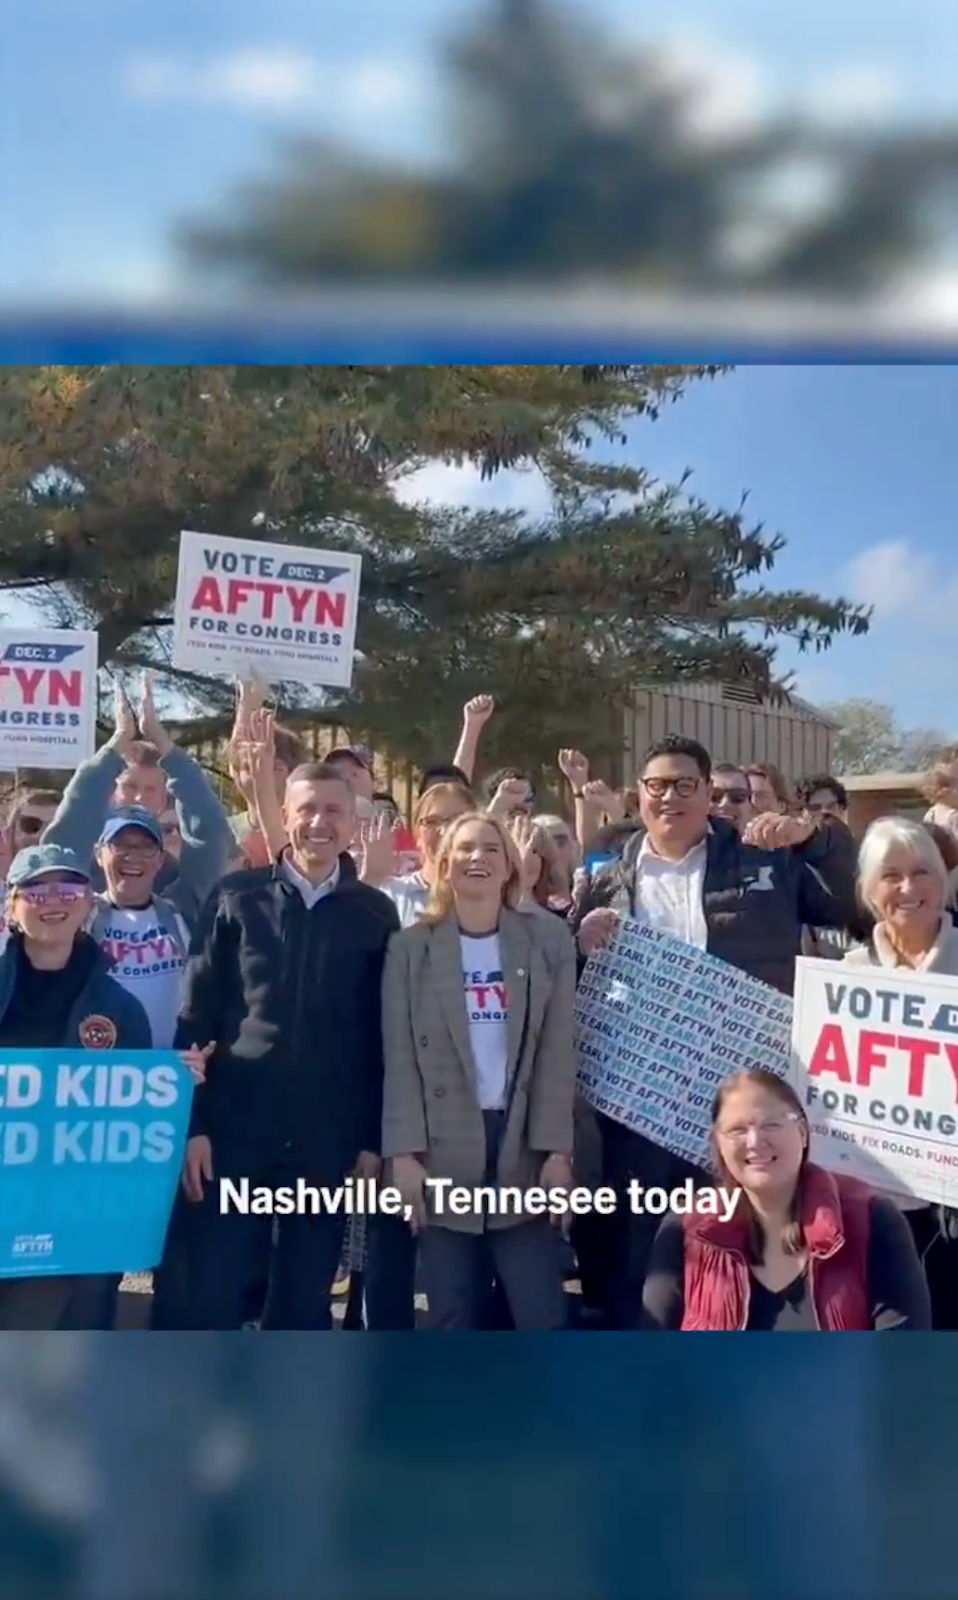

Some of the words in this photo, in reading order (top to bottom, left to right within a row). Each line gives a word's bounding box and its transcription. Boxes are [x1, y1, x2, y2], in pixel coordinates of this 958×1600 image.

[204, 549, 274, 578] VOTE
[287, 566, 315, 579] DEC.
[317, 568, 325, 580] 2
[191, 576, 346, 628] AFTYN
[189, 616, 228, 634] FOR
[235, 622, 342, 646] CONGRESS
[15, 646, 45, 659] DEC.
[48, 648, 57, 659] 2
[623, 922, 664, 942] EARLY
[617, 946, 653, 967] EARLY
[732, 994, 766, 1014] VOTE
[766, 1008, 794, 1026] EAR
[661, 950, 693, 969] VOTE
[694, 964, 738, 989] AFTYN
[586, 961, 610, 976] OTE
[720, 1018, 754, 1038] VOTE
[650, 974, 682, 994] VOTE
[683, 988, 726, 1013] AFTYN
[825, 982, 926, 1028] VOTE
[638, 999, 670, 1018] VOTE
[671, 1013, 714, 1037] AFTYN
[588, 1018, 621, 1039] EARLY
[697, 1067, 724, 1085] VOT
[628, 1022, 658, 1042] VOTE
[660, 1036, 703, 1061] AFTYN
[709, 1043, 743, 1063] VOTE
[55, 1064, 179, 1108] KIDS
[578, 1041, 610, 1064] EARLY
[686, 1092, 712, 1109] VOT
[604, 1071, 636, 1092] VOTE
[636, 1086, 680, 1111] AFTYN
[616, 1046, 647, 1067] VOTE
[648, 1061, 691, 1087] AFTYN
[692, 1081, 717, 1097] VOT
[593, 1096, 624, 1116] VOTE
[624, 1110, 668, 1136] AFTYN
[806, 1086, 858, 1116] FOR
[53, 1120, 176, 1165] KIDS
[673, 1116, 707, 1138] VOTE
[862, 1136, 880, 1148] FIX
[882, 1140, 924, 1159] ROADS.
